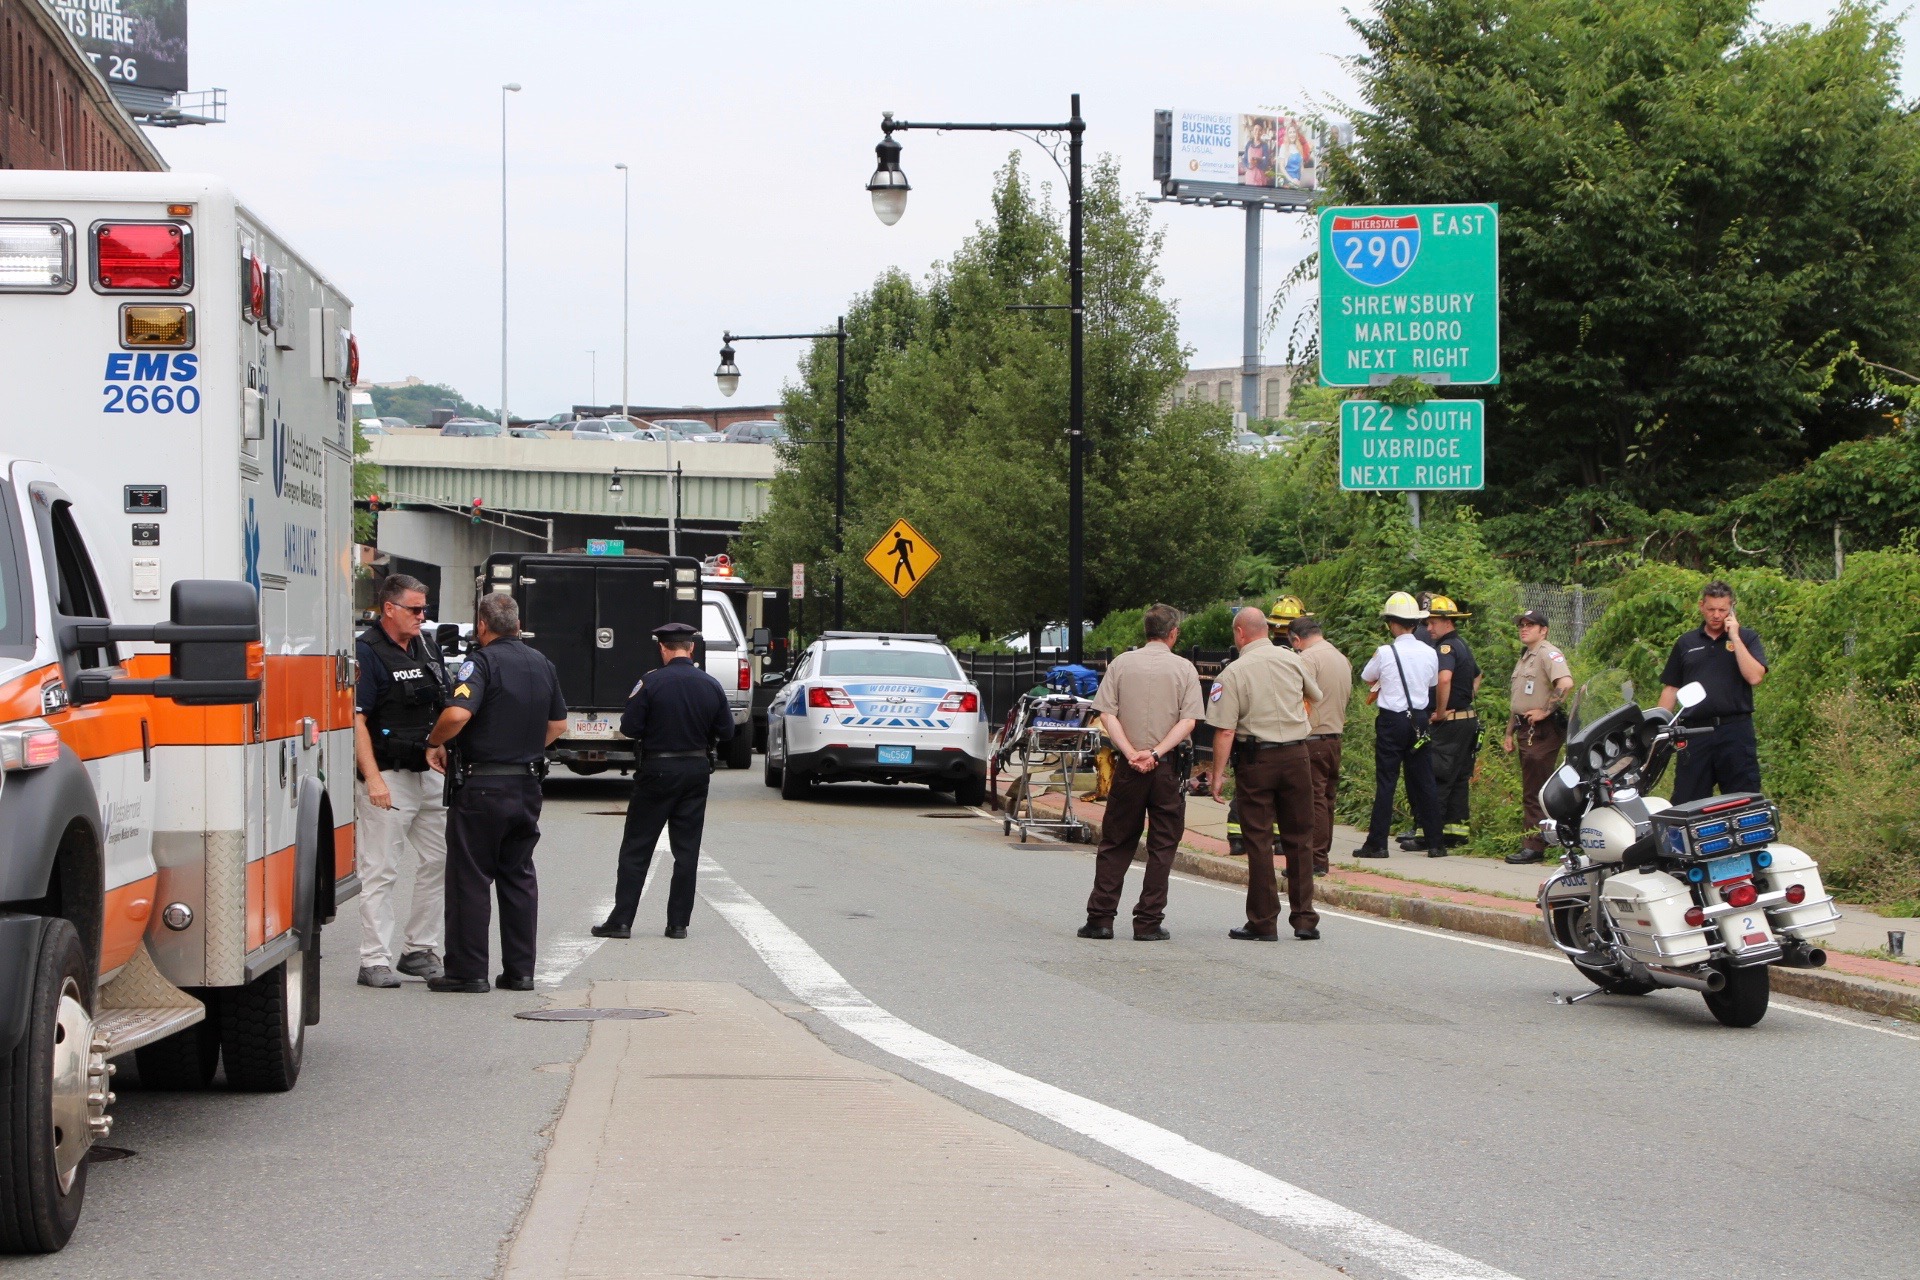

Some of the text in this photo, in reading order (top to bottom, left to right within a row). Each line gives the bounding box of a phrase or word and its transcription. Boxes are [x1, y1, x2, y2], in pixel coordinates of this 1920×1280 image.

[109, 55, 137, 81] 26
[1182, 113, 1232, 123] ANYTHING BUT
[1182, 121, 1231, 135] BUSINESS
[1182, 133, 1231, 147] BANKING
[1192, 146, 1213, 154] USUAL
[1351, 213, 1485, 235] INTERSTATE EAST
[1344, 235, 1411, 269] 290
[1341, 294, 1475, 315] SHREWSBURY
[1355, 321, 1462, 342] MARLBORO
[1347, 347, 1470, 369] NEXT RIGHT
[104, 353, 198, 382] EMS
[103, 384, 200, 414] 2660
[1352, 405, 1472, 431] 122 SOUTH
[1363, 438, 1460, 458] UXBRIDGE
[1351, 465, 1473, 485] NEXT RIGHT
[284, 521, 317, 577] AMBULANCE
[591, 544, 606, 552] 290
[393, 668, 423, 681] POLICE
[869, 685, 923, 694] WORCESTER
[870, 704, 921, 714] POLICE
[823, 714, 831, 724] 5
[593, 723, 608, 732] 437
[890, 750, 910, 760] C567
[1580, 838, 1606, 849] OLICE
[1560, 874, 1588, 887] POLICE
[1742, 917, 1755, 930] 2
